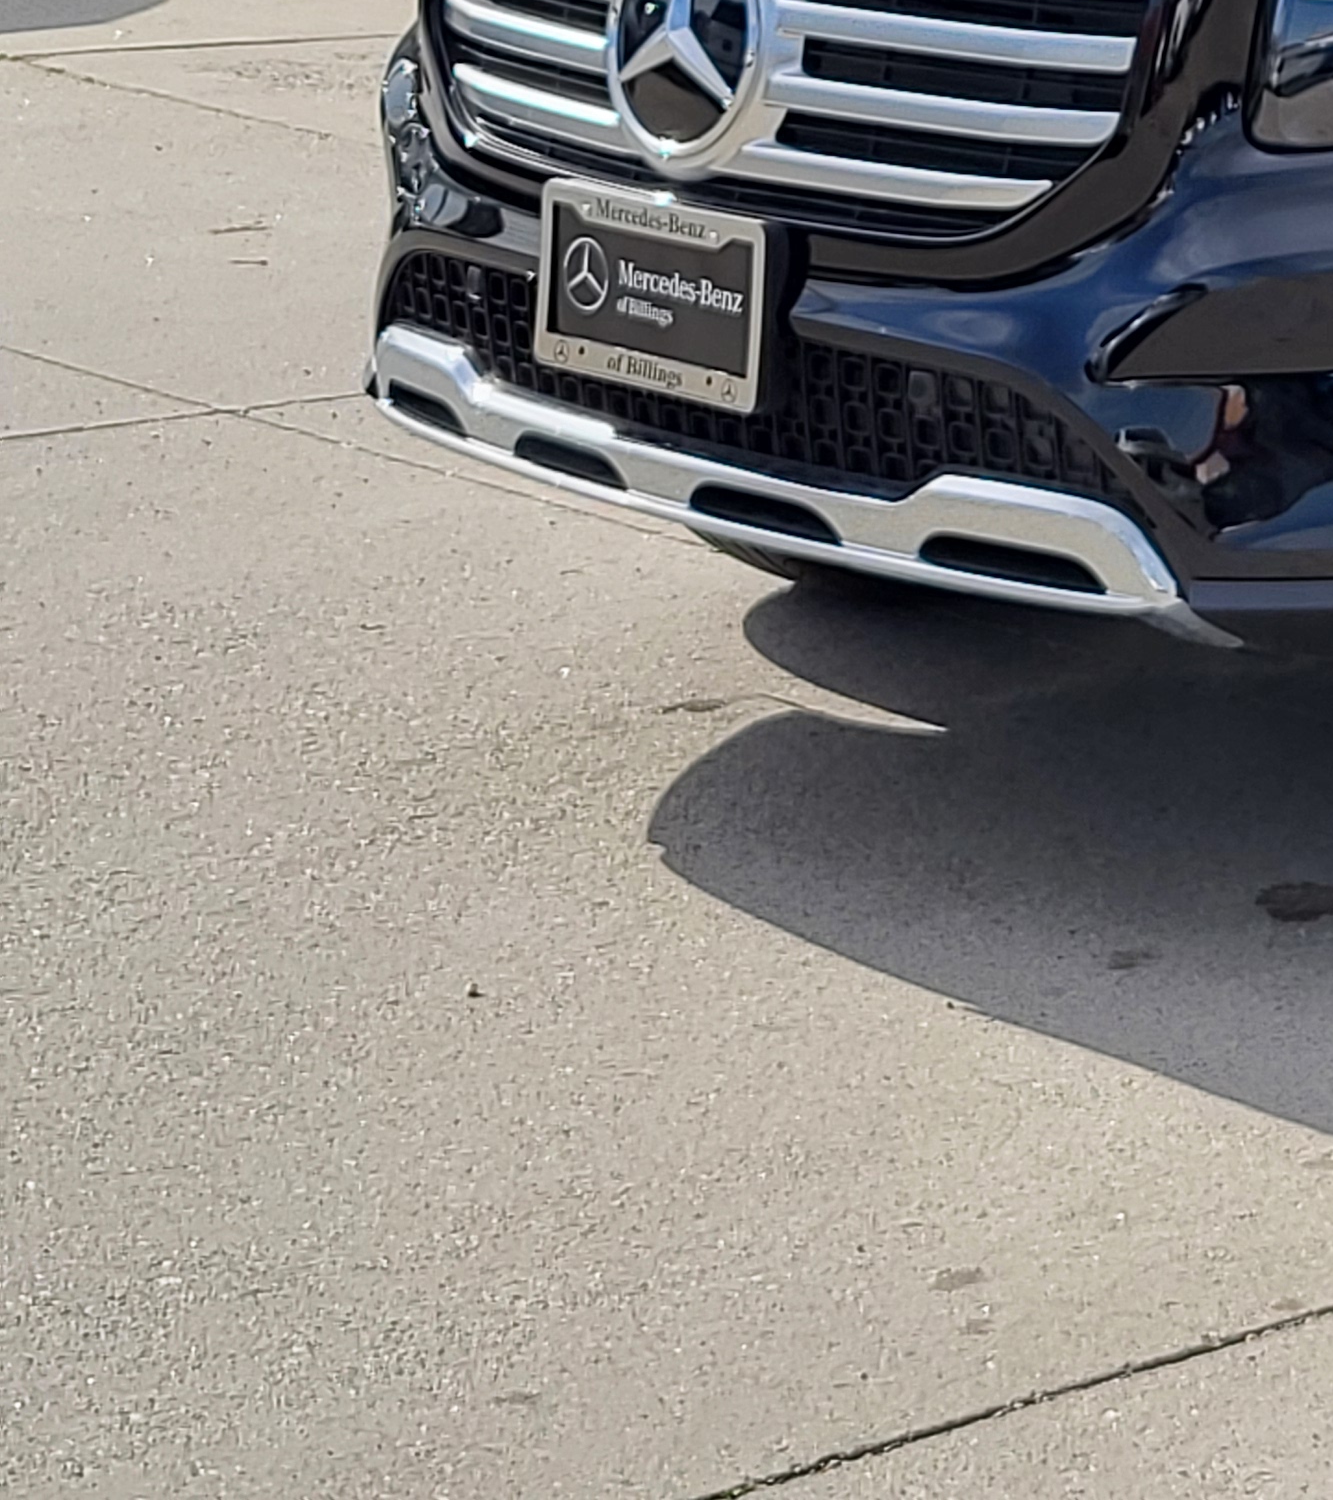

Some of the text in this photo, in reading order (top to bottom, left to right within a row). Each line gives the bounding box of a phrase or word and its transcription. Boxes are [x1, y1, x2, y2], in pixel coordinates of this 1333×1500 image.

[596, 198, 706, 238] Mercedes-Benz
[618, 259, 744, 313] Mercedes-Benz
[628, 298, 674, 328] Billings
[607, 354, 683, 389] of Billings
